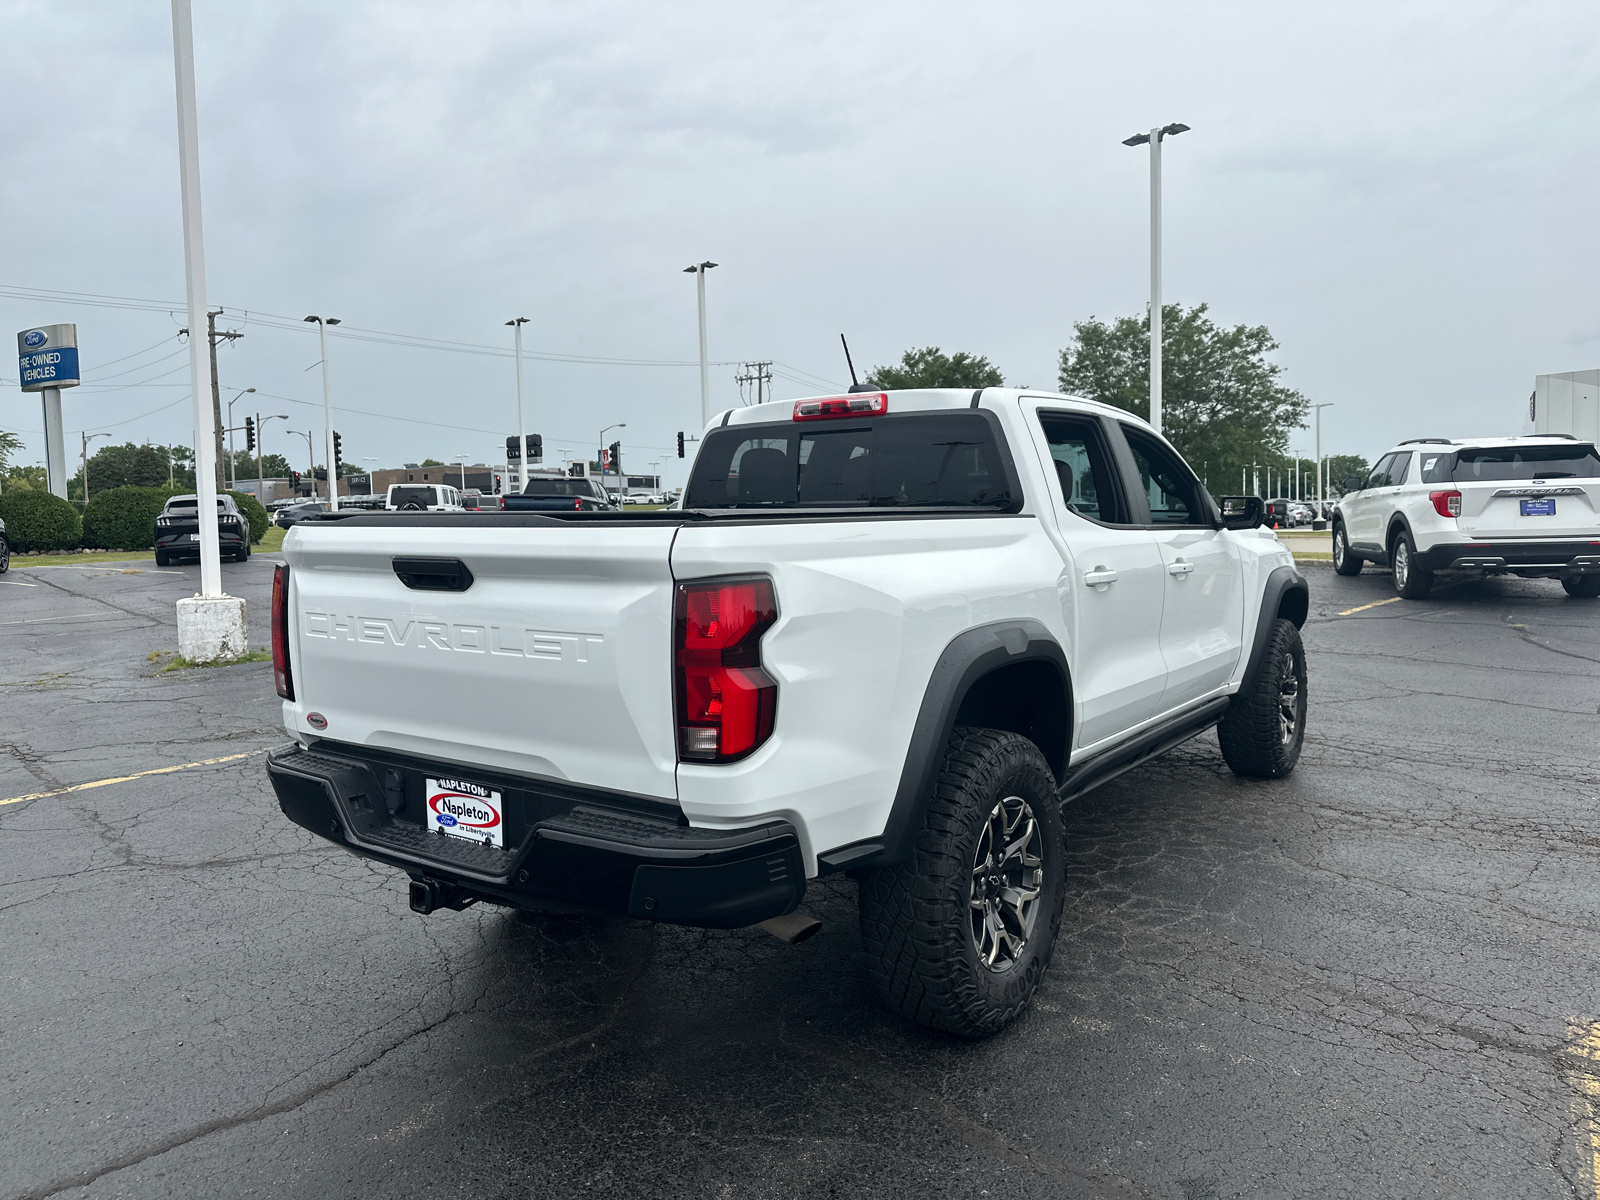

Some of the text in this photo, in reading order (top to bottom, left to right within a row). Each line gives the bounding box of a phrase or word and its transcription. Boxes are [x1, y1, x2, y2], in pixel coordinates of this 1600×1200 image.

[20, 352, 61, 370] PRE-OWNED
[24, 366, 56, 381] VEHICLES
[508, 449, 535, 457] LINLN
[305, 611, 604, 662] CHEVROLET
[440, 778, 487, 797] NAPLETON
[442, 797, 490, 822] Napleton
[465, 825, 496, 839] Libertyville
